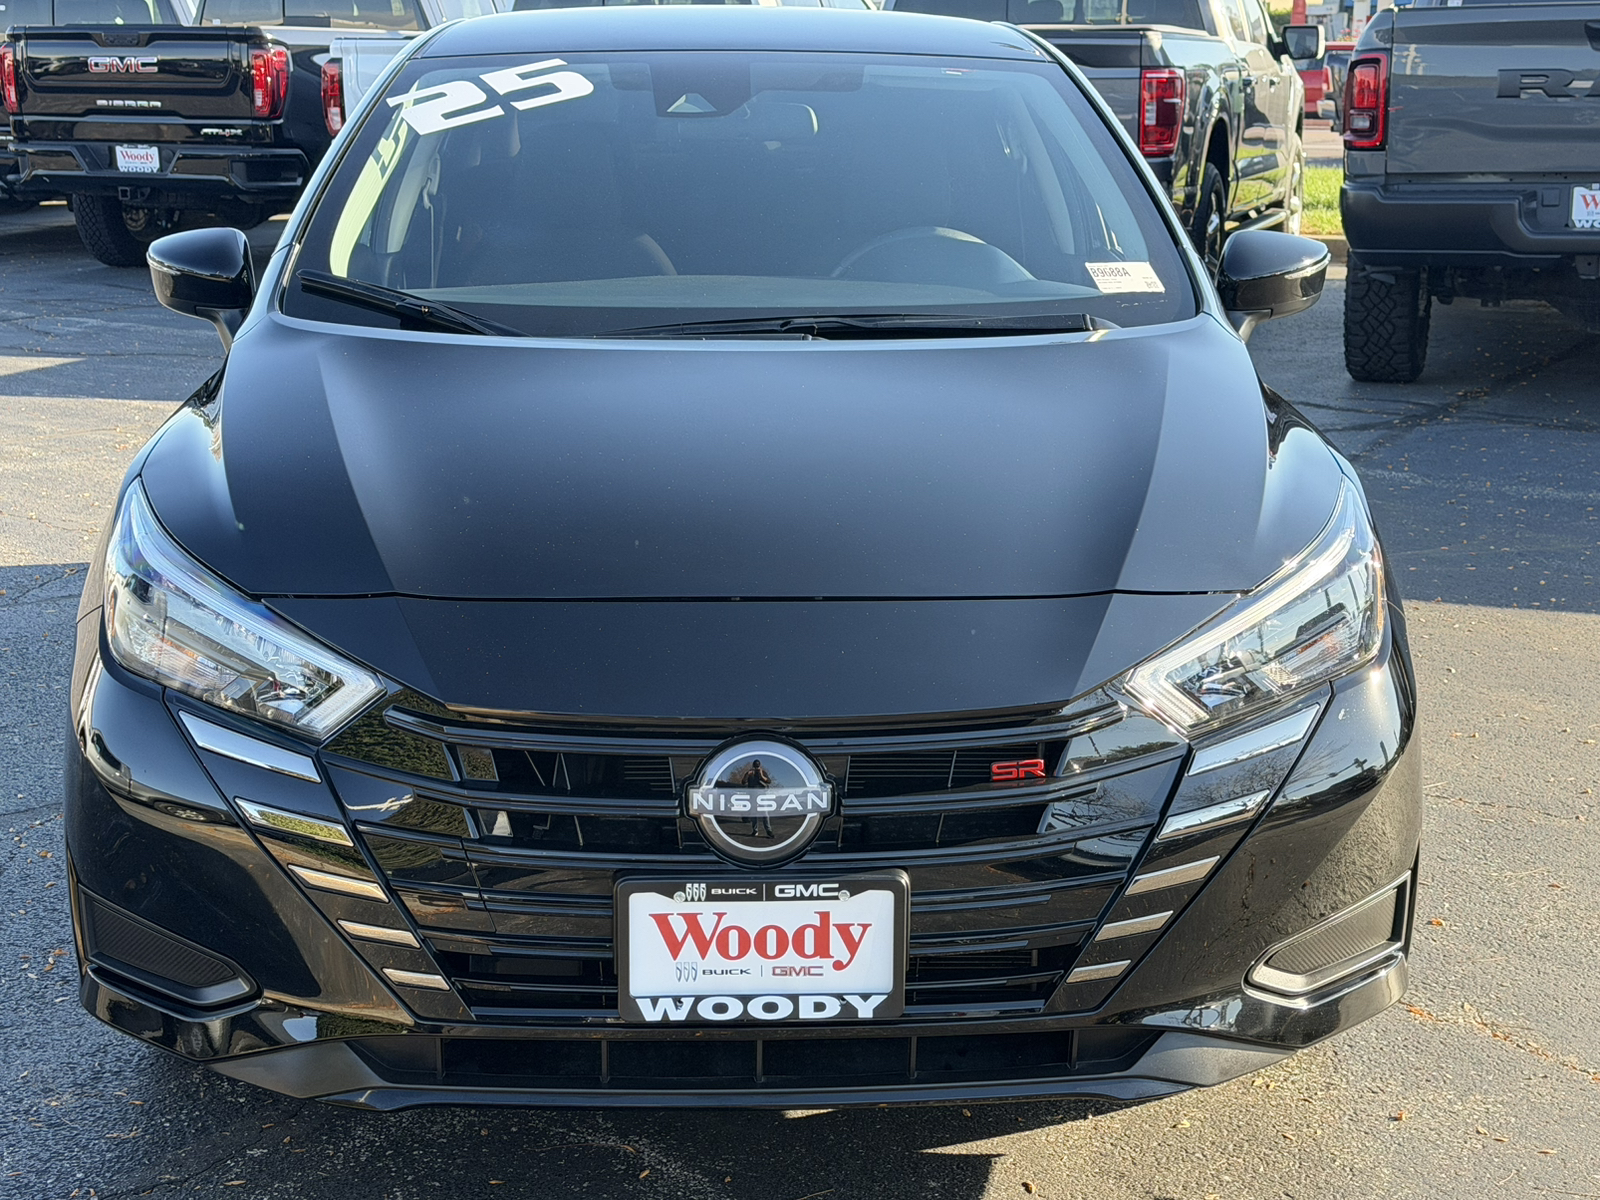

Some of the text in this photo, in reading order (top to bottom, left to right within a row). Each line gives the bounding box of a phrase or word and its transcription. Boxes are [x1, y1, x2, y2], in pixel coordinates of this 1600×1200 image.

[87, 57, 158, 73] GMC
[386, 58, 594, 136] 25
[120, 150, 155, 164] Woody
[991, 759, 1046, 782] SR
[692, 791, 828, 812] NISSAN
[774, 883, 840, 898] GMC
[648, 911, 872, 971] Woody
[702, 965, 824, 977] BUICK GMC
[635, 995, 888, 1021] WOODY
